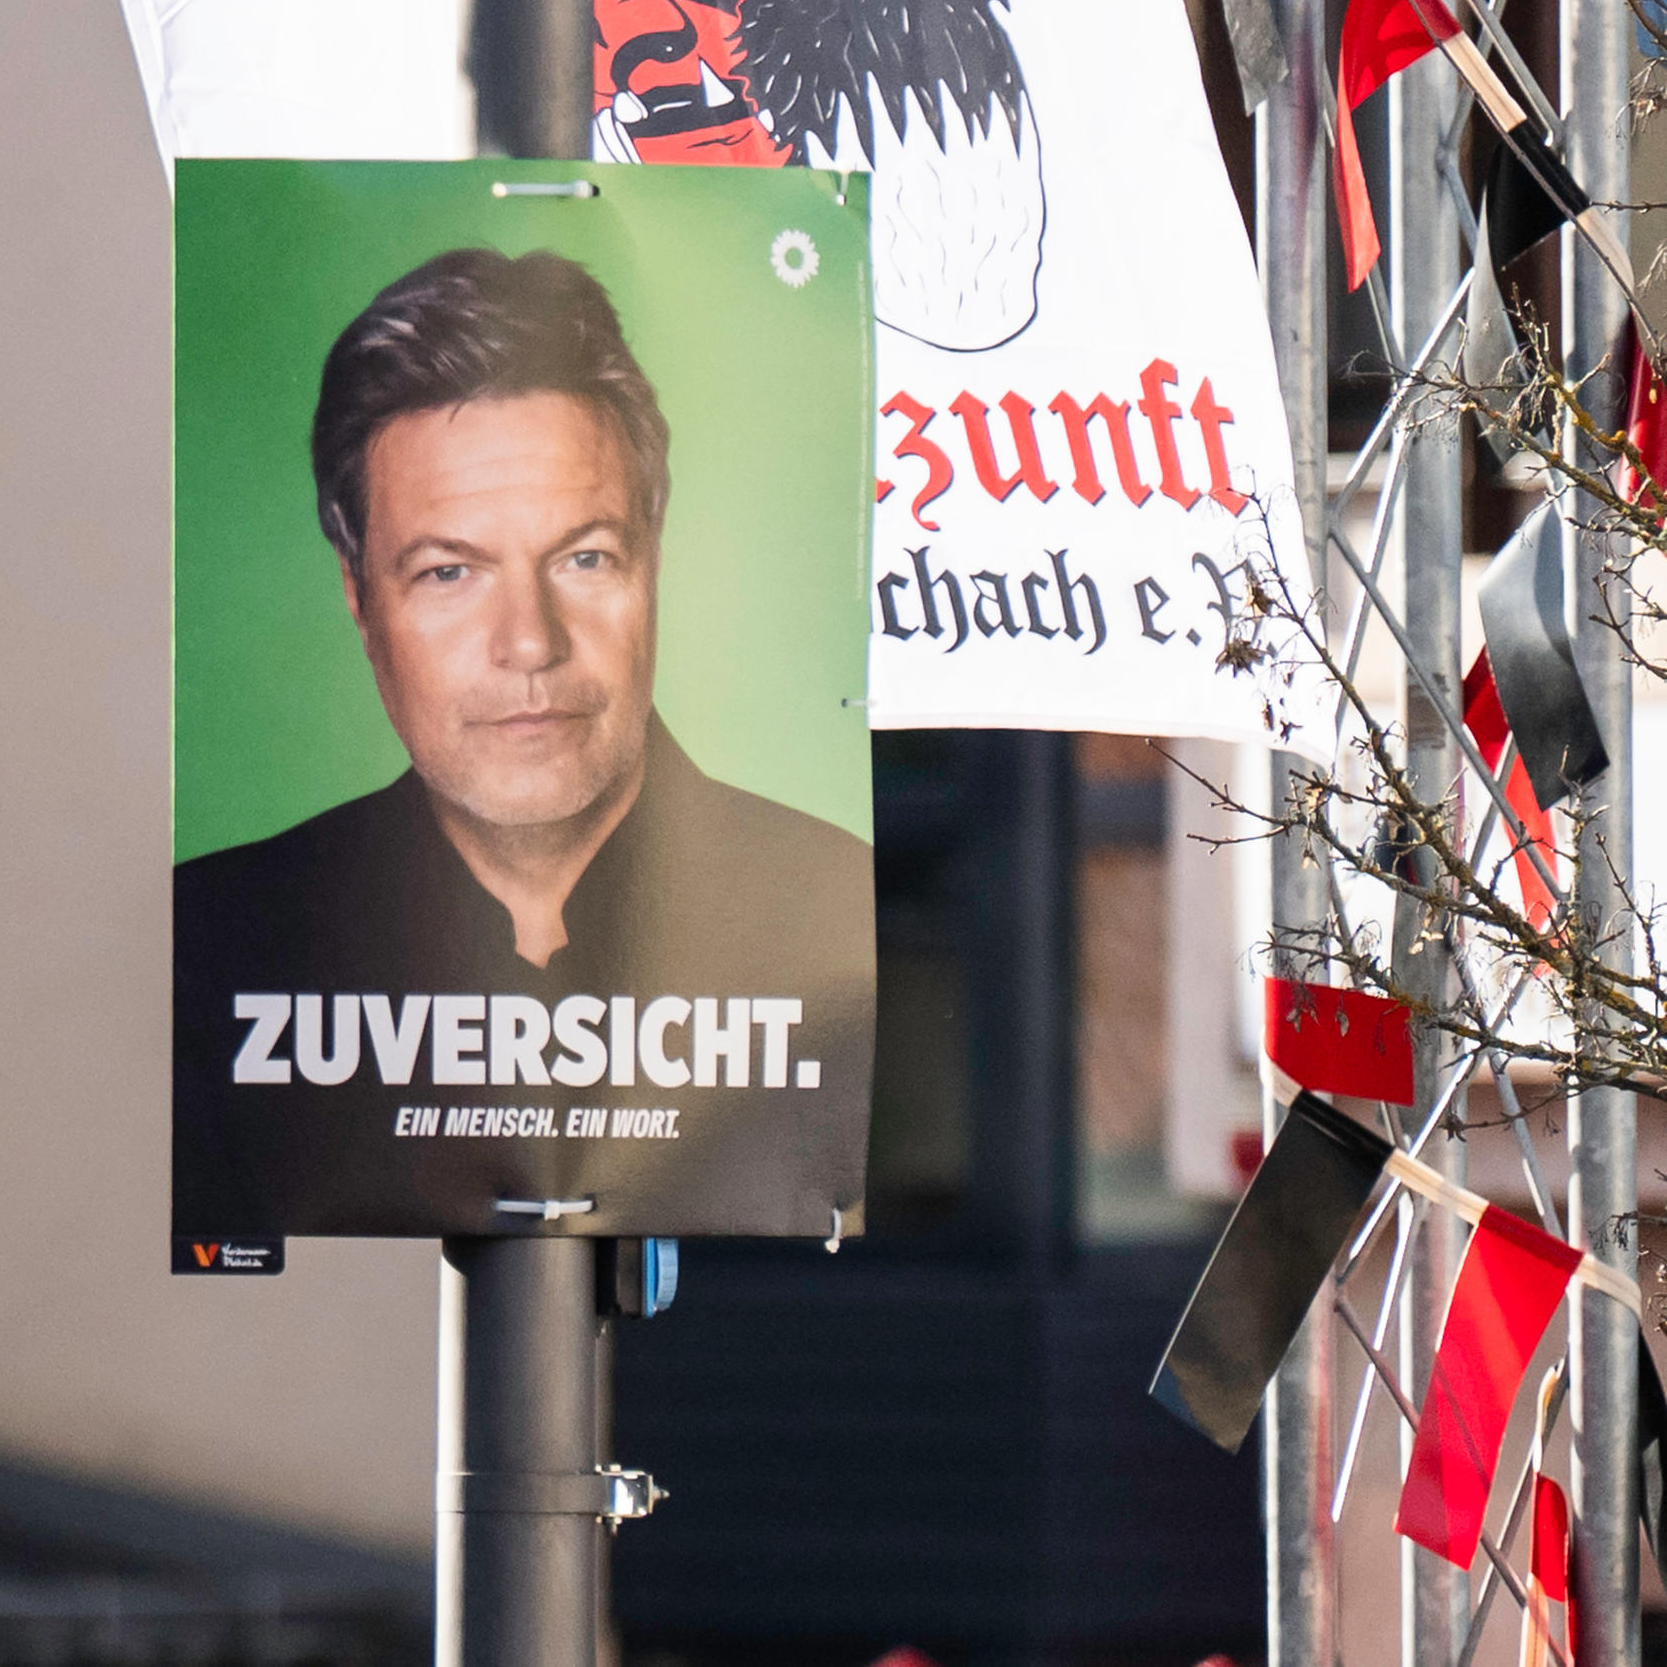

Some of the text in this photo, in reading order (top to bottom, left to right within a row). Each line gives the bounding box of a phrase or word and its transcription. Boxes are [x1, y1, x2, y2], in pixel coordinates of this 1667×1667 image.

[874, 357, 1249, 532] zunft
[870, 545, 1107, 656] chach
[232, 993, 822, 1089] ZUVERSICHT.
[394, 1107, 681, 1140] EIN MENSCH. EIN WORT.
